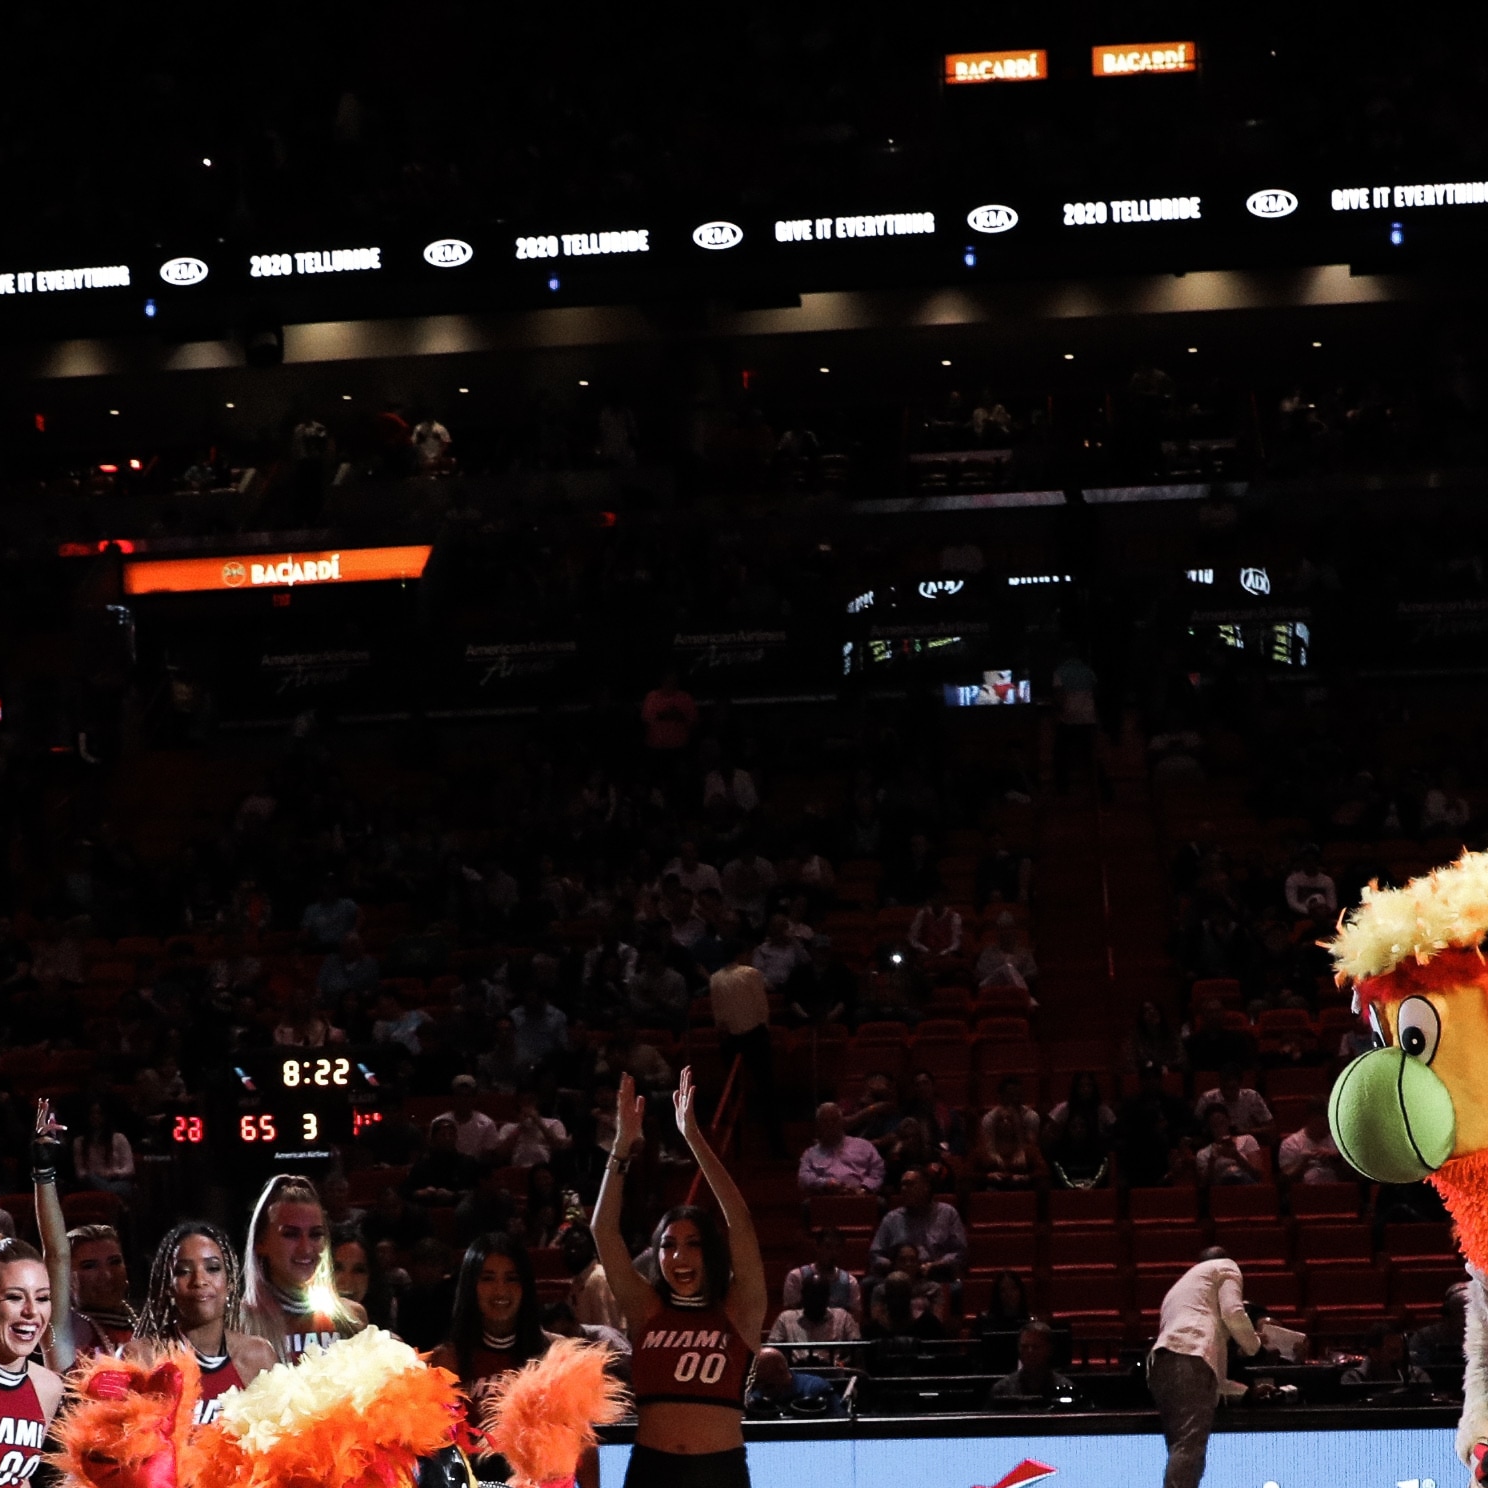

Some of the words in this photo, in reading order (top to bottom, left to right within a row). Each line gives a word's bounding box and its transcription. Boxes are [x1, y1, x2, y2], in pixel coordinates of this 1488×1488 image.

[1331, 187, 1370, 211] GIVE
[1372, 186, 1391, 209] IT
[774, 219, 814, 243] GIVE
[815, 217, 834, 240] IT
[835, 211, 936, 239] EVERYTHING
[16, 271, 35, 294] IT
[282, 1057, 350, 1087] 8:22
[240, 1114, 277, 1142] 65
[302, 1112, 319, 1141] 3
[673, 1351, 727, 1384] 00
